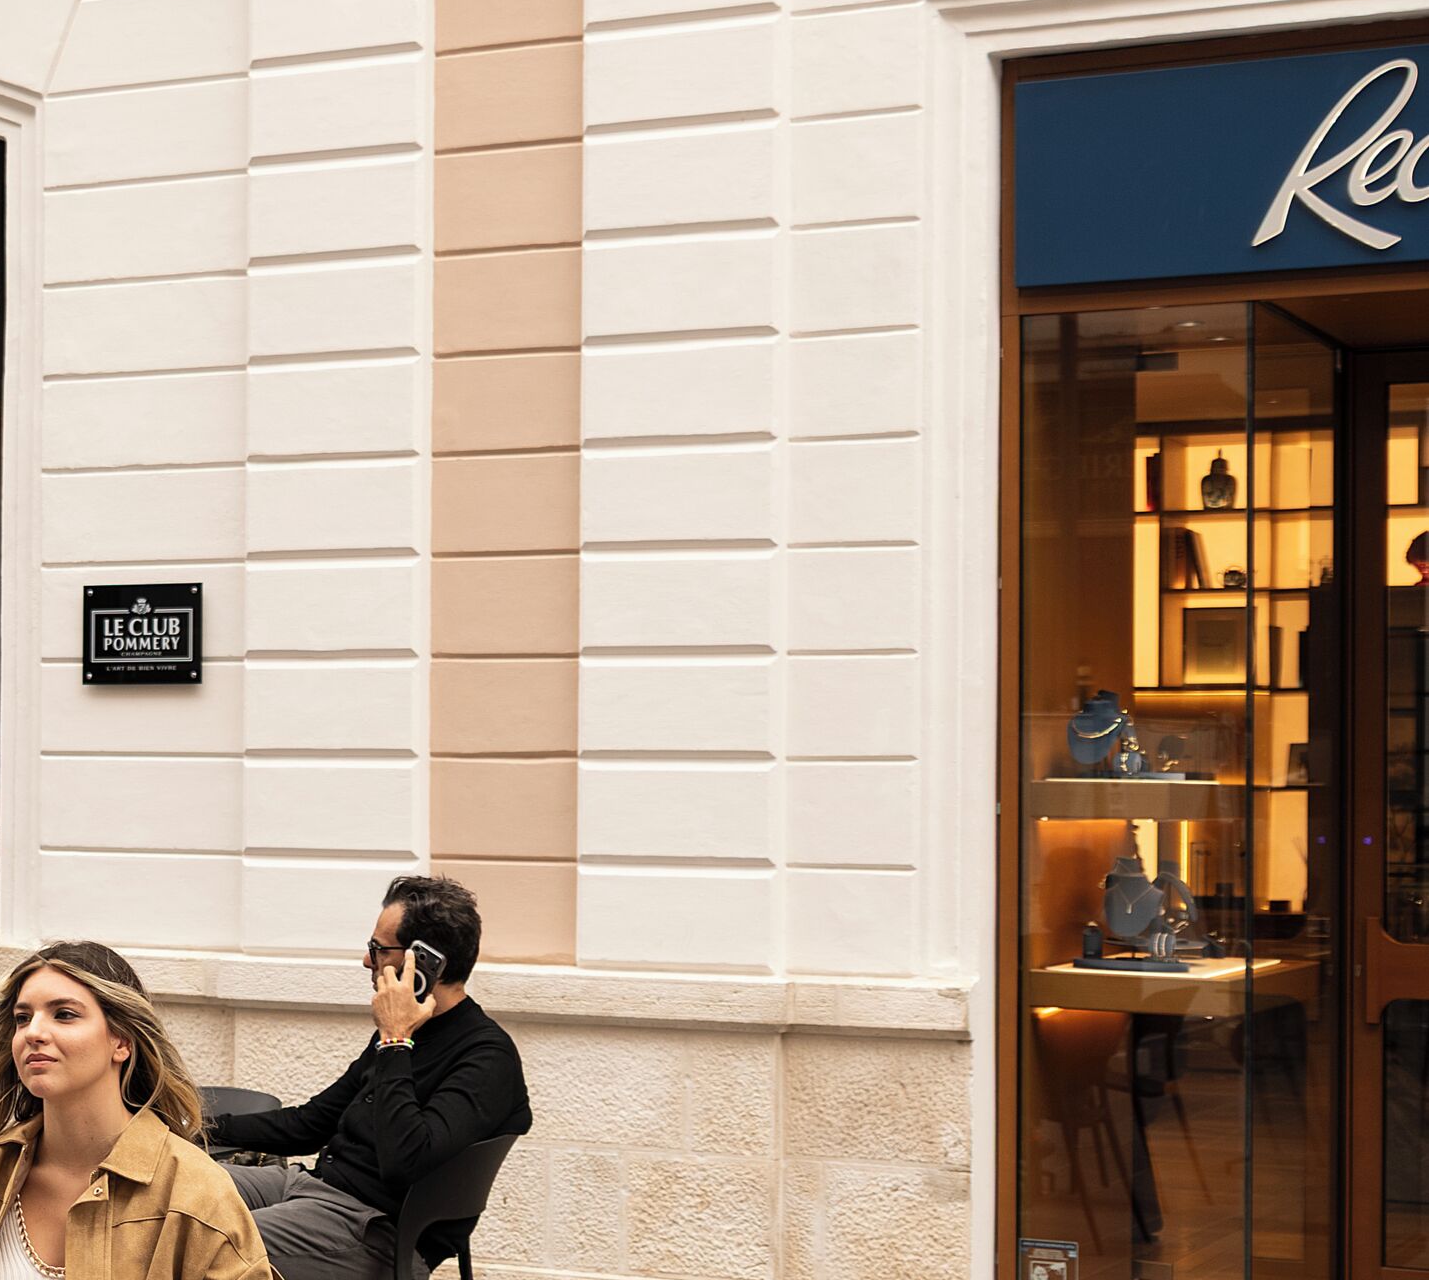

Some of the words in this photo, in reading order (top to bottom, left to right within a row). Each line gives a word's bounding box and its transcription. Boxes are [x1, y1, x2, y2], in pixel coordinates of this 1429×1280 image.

[103, 619, 124, 637] LE
[128, 617, 181, 636] CLUB
[103, 636, 180, 651] POMMERY
